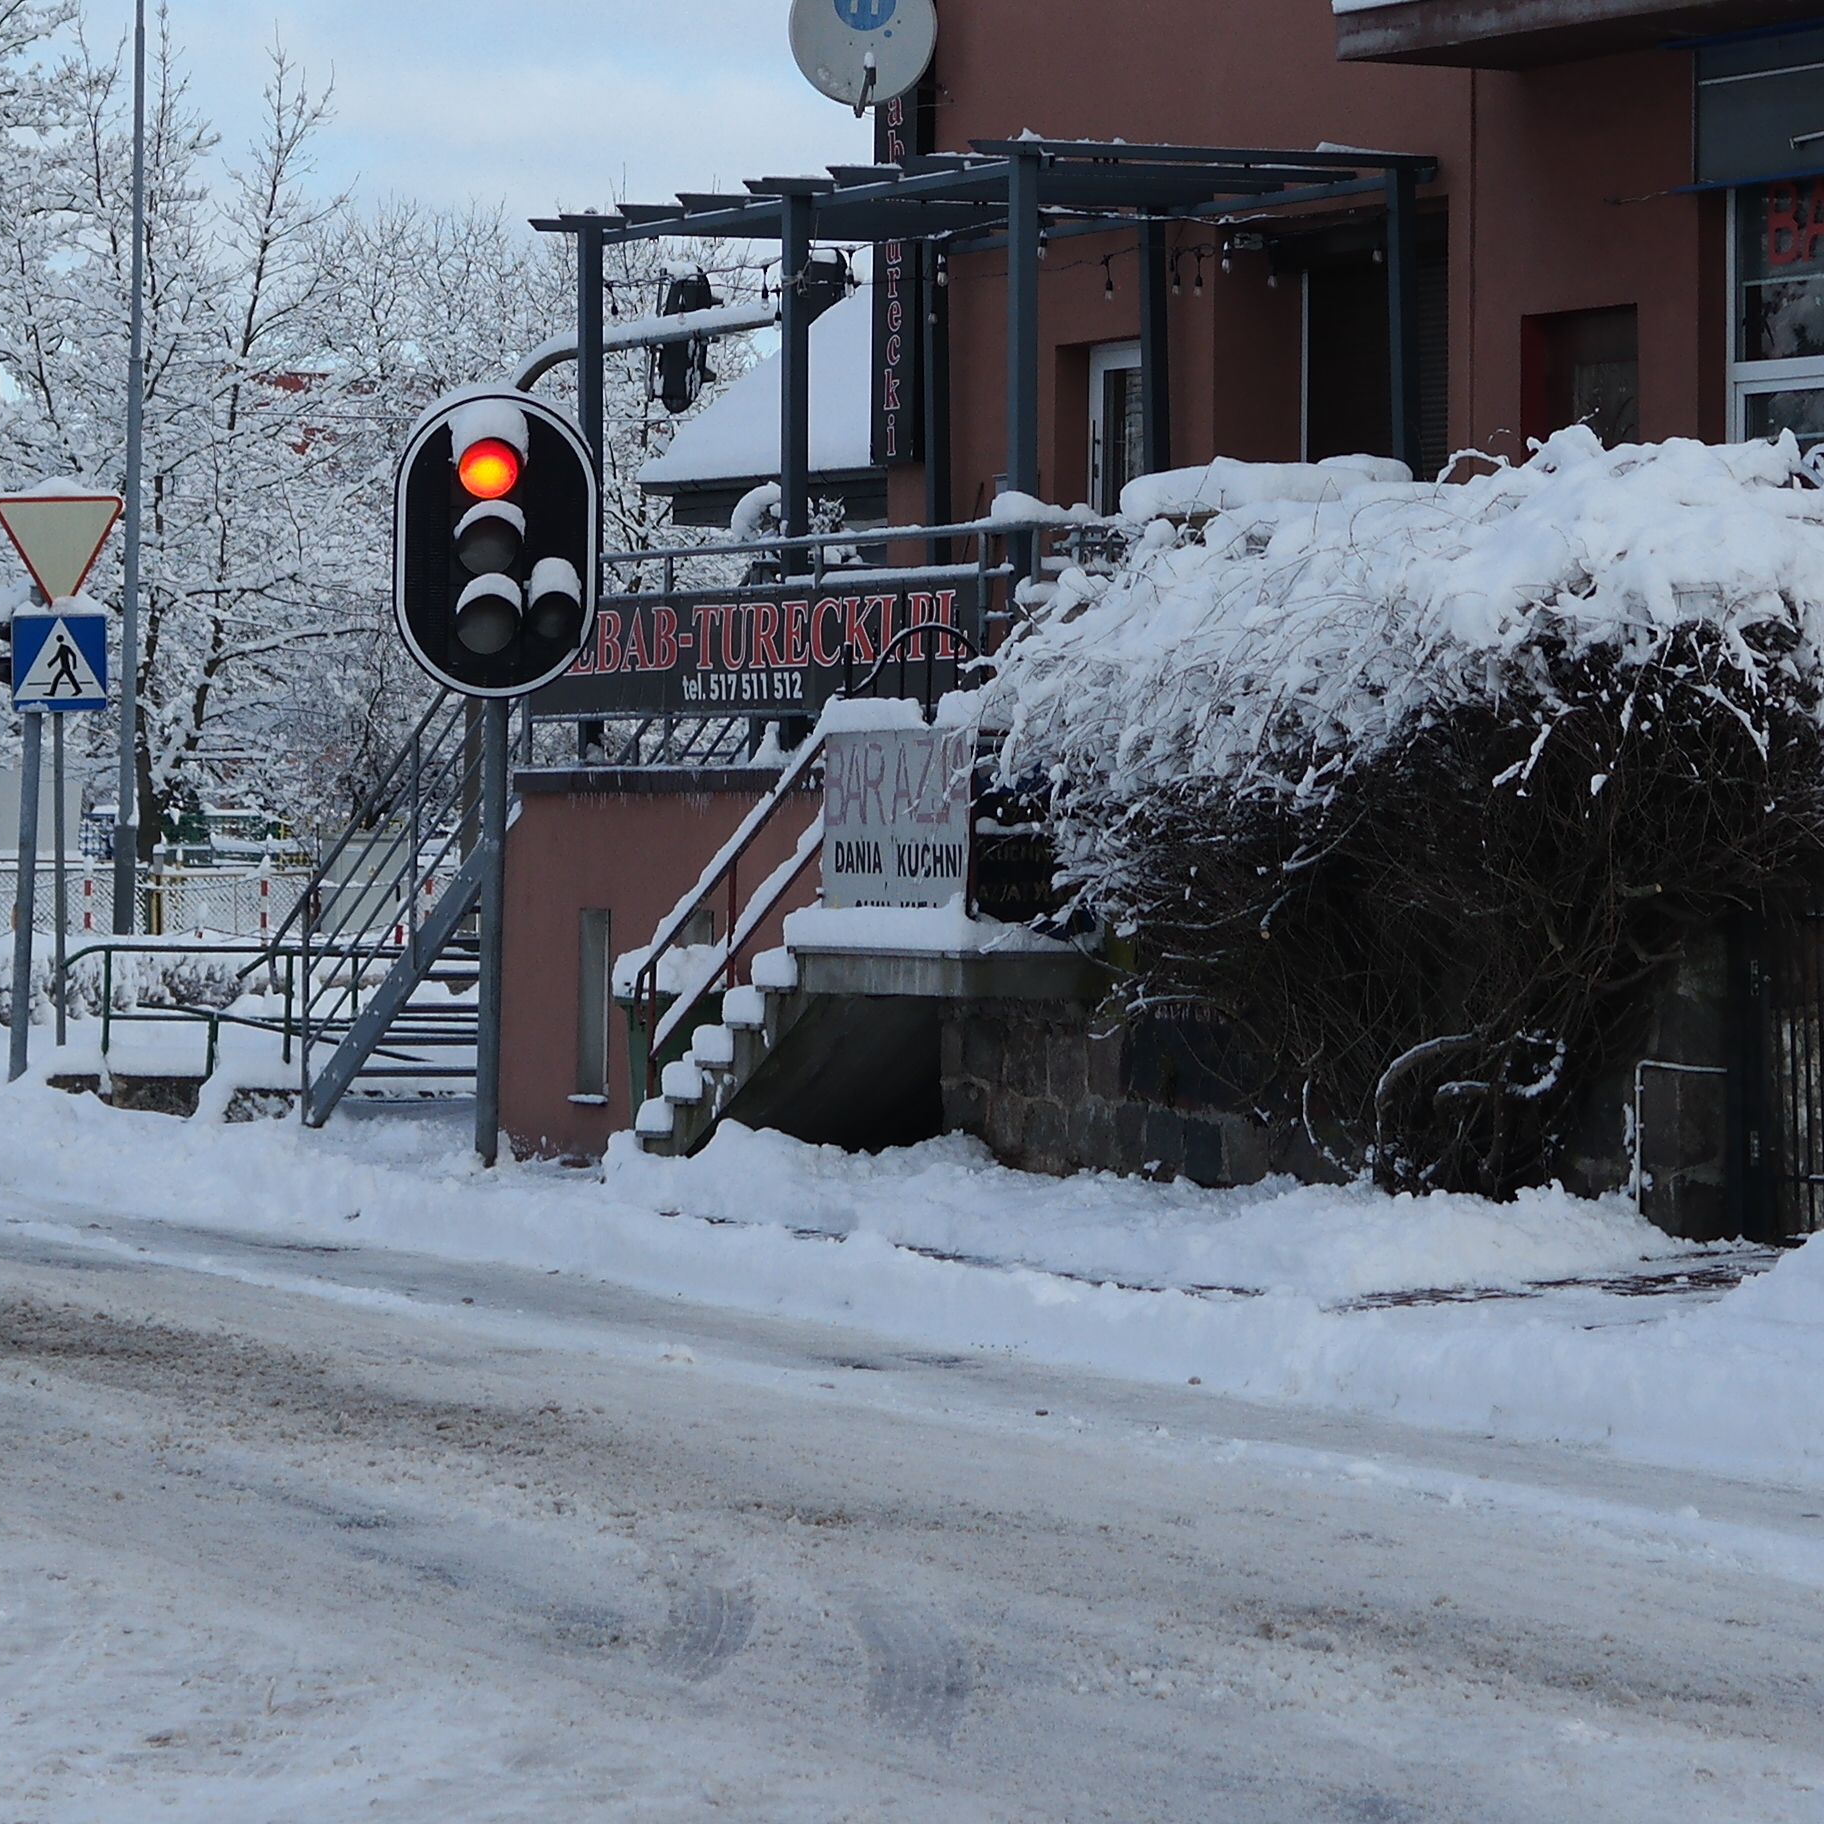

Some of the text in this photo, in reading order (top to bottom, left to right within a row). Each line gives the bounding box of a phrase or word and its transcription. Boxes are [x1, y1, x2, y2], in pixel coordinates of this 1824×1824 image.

[883, 241, 903, 456] urecki
[563, 588, 968, 677] BAB-TURECKI.PL
[682, 671, 803, 701] tel. 517 511 512
[825, 738, 970, 826] BAR AZJA
[835, 840, 963, 878] DANIA KUCHNI
